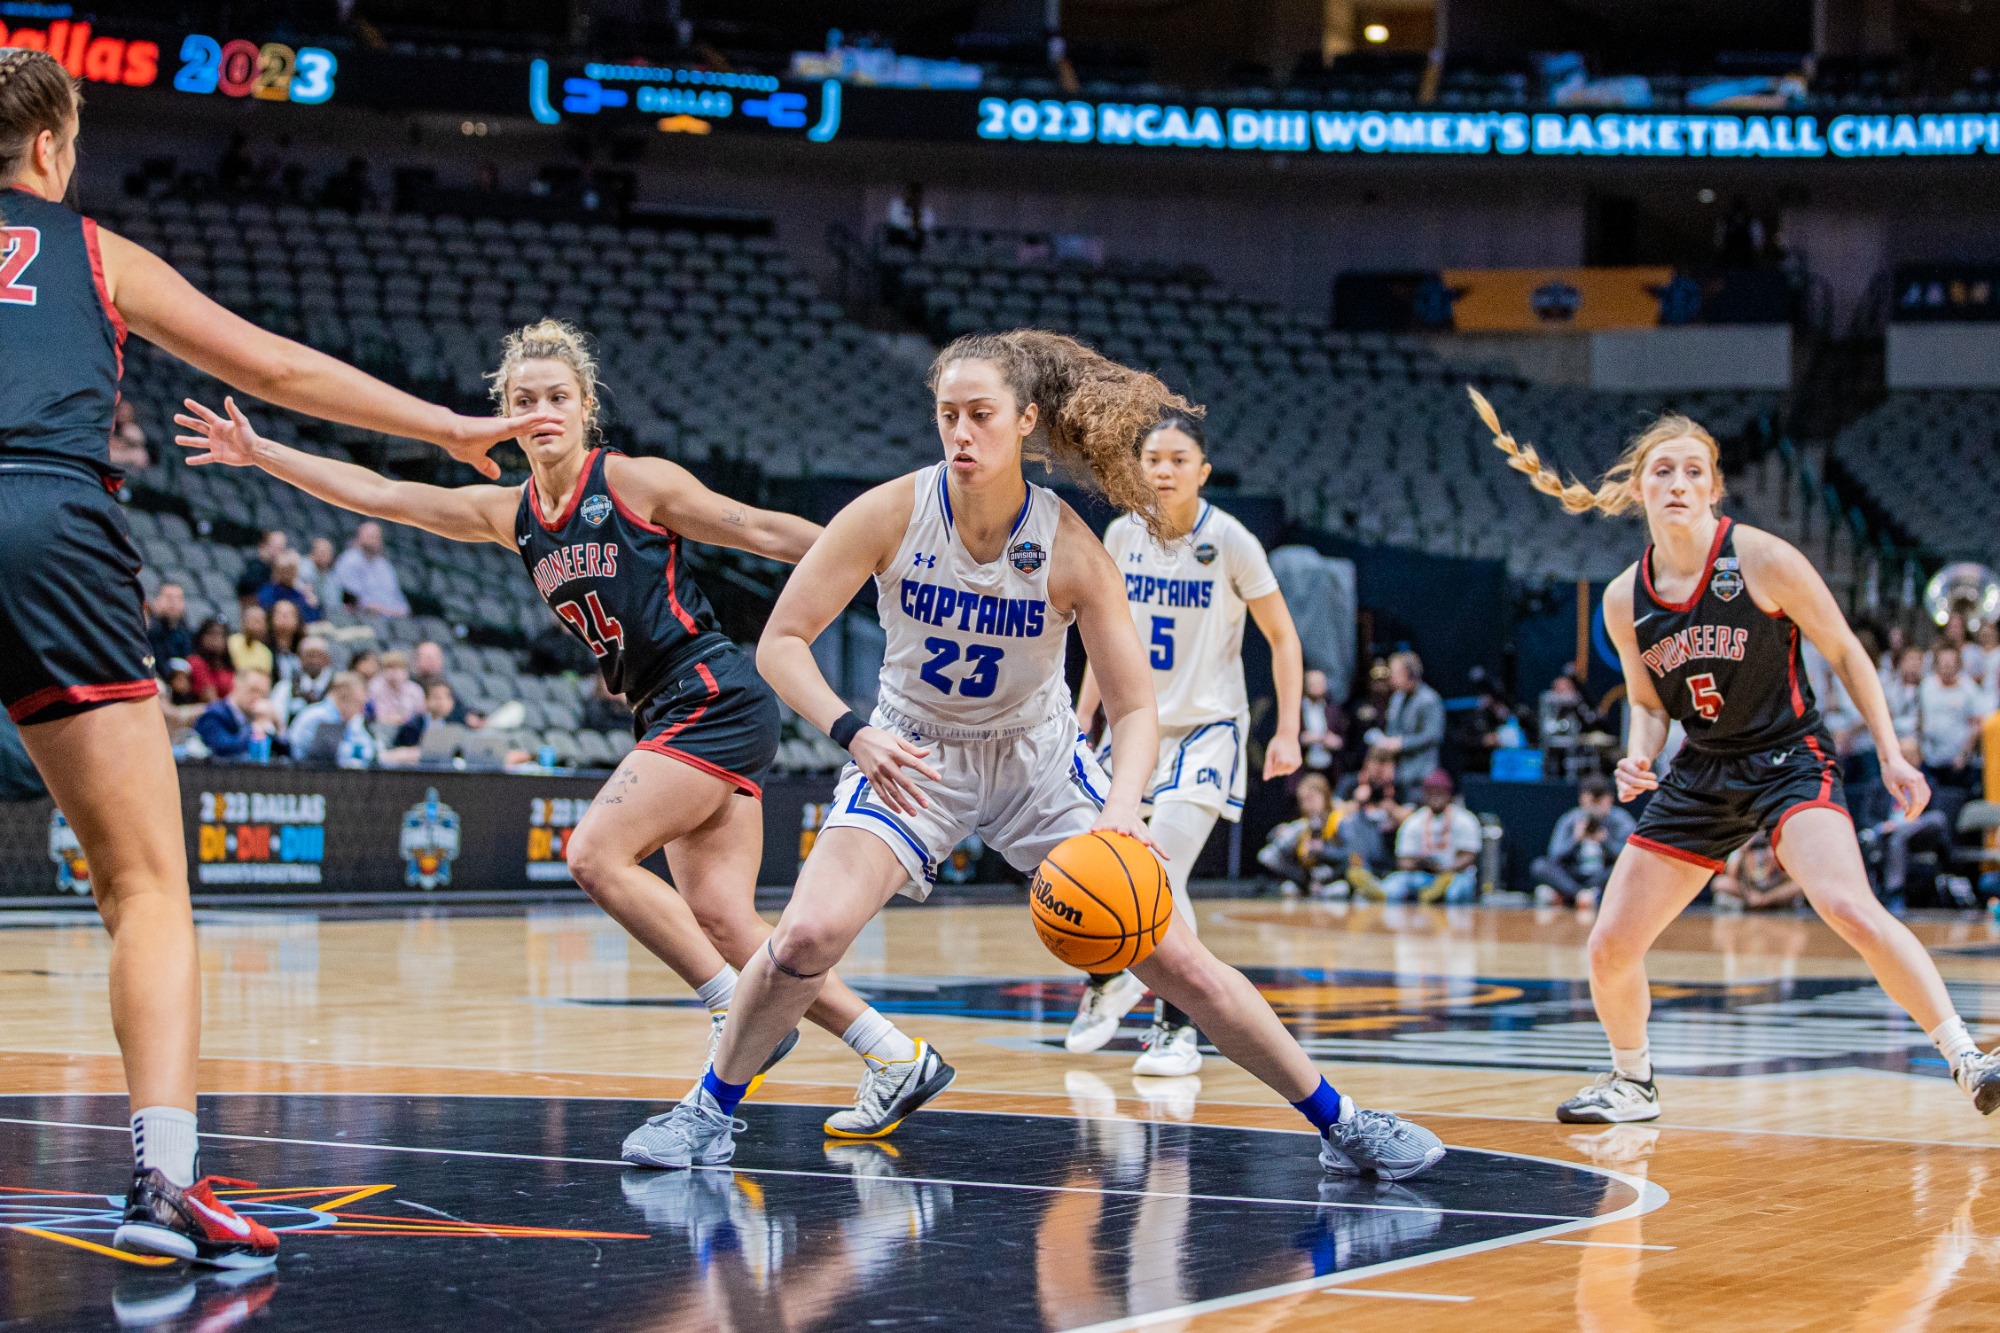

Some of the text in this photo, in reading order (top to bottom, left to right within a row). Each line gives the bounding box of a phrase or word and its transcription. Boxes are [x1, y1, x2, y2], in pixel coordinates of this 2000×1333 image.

[173, 34, 338, 104] 2023
[978, 97, 1095, 143] 2023
[1097, 104, 1226, 148] NCAA
[1227, 108, 1310, 150] DIII
[1311, 110, 1531, 154] WOMEN'S
[1532, 113, 1827, 157] BASKETBALL
[0, 226, 41, 306] 2
[1010, 551, 1038, 560] DIVISION
[901, 578, 1046, 638] CAPTAINS
[1125, 573, 1214, 608] CAPTAINS
[556, 590, 625, 658] 24
[1150, 615, 1175, 671] 5
[1641, 625, 1748, 678] PIONEERS
[920, 636, 1005, 698] 23
[1686, 672, 1725, 723] 5
[251, 793, 326, 824] DALLAS
